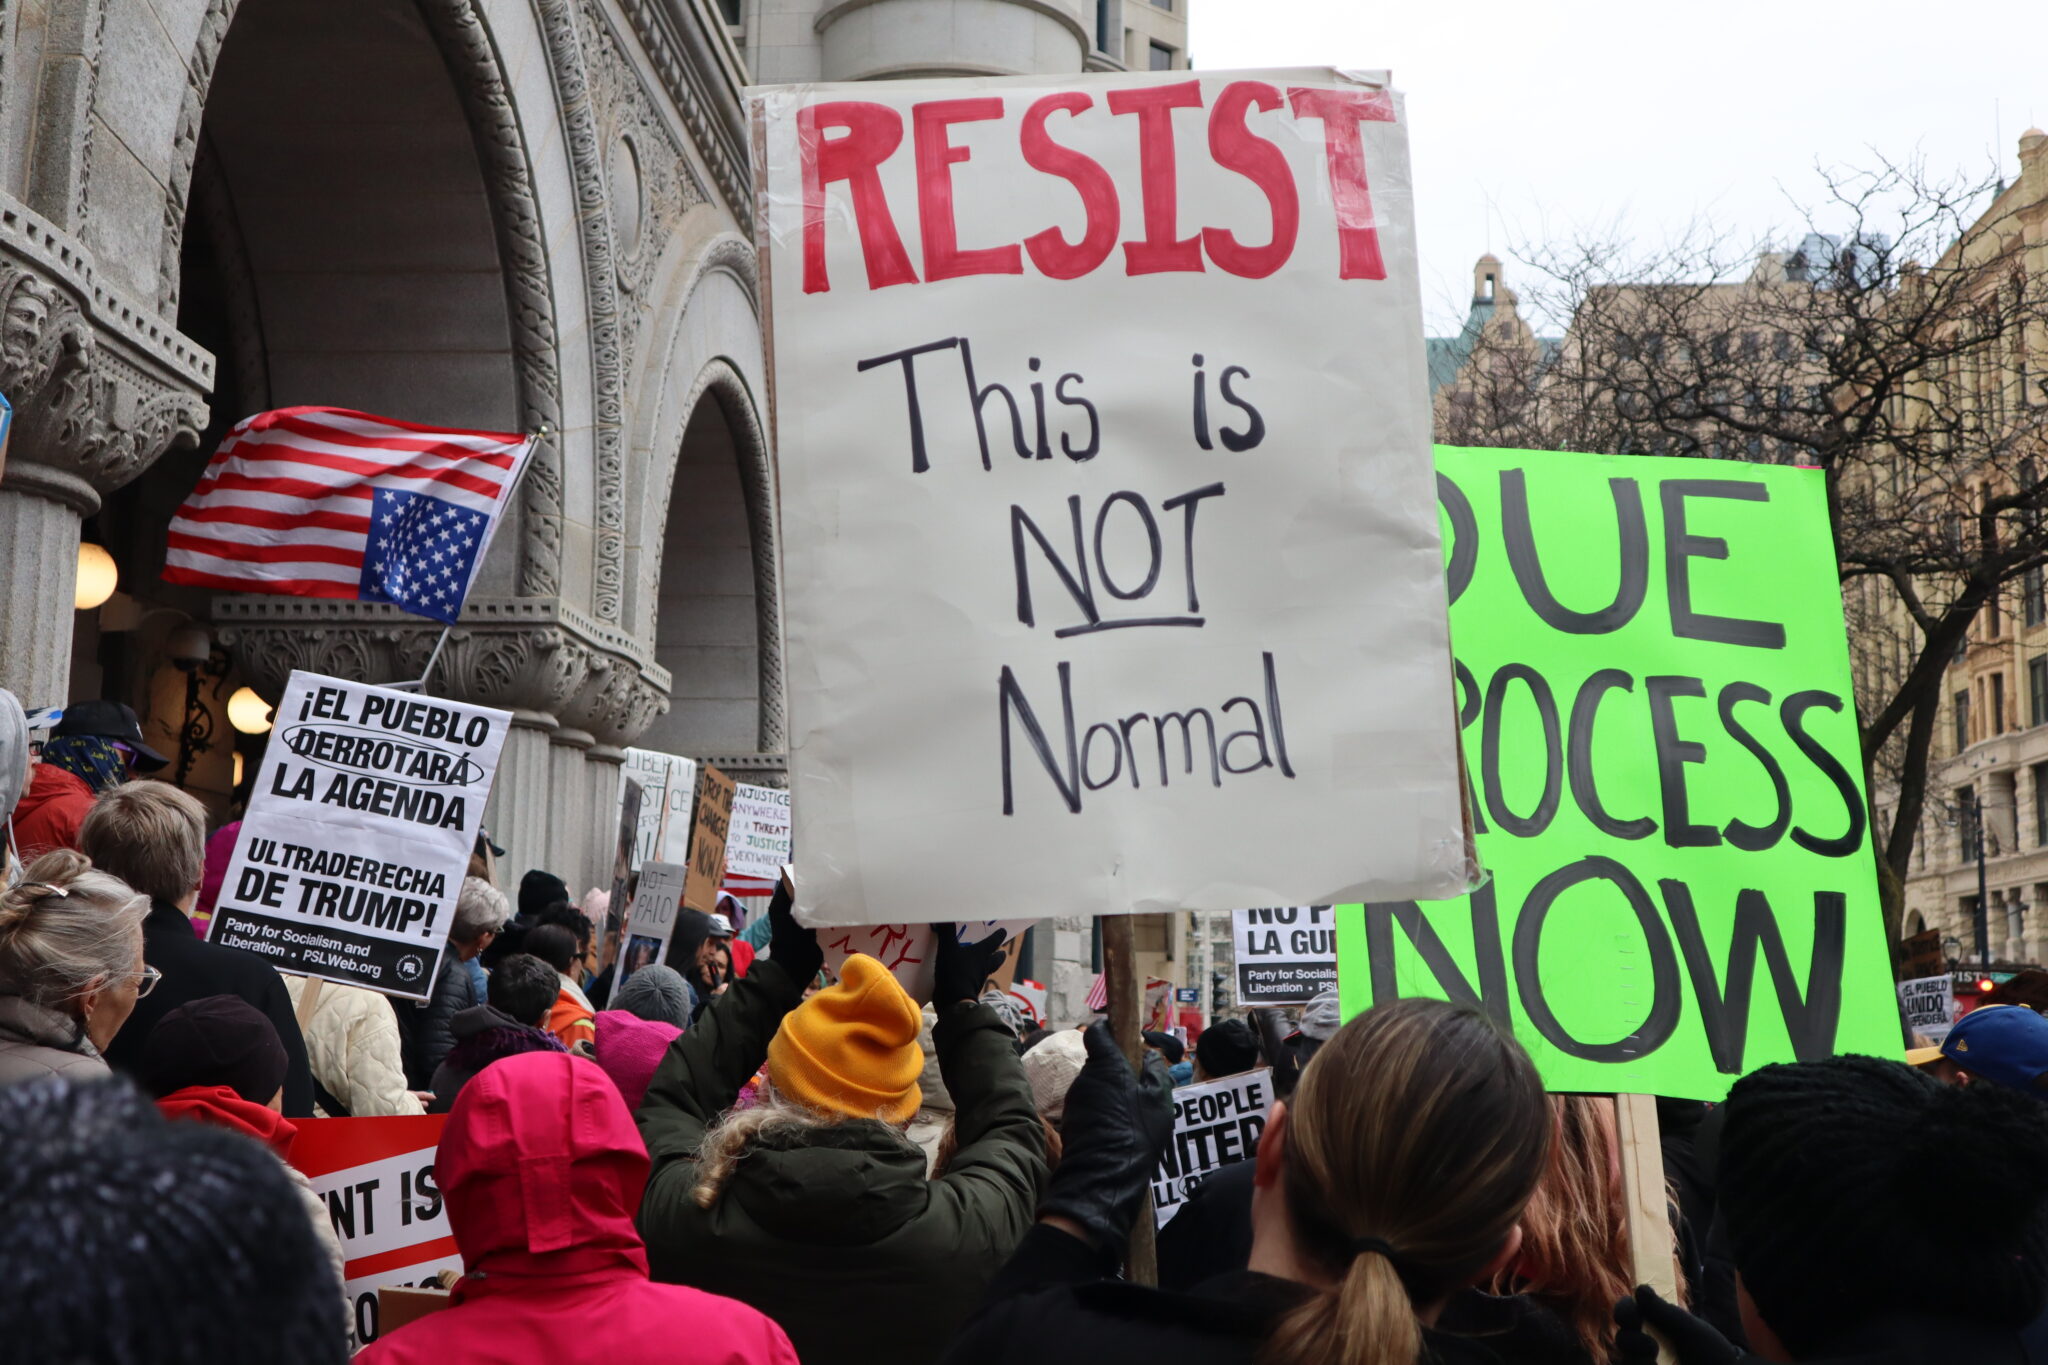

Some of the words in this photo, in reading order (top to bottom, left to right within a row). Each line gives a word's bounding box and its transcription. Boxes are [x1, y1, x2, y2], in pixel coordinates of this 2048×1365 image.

[796, 79, 1396, 294] RESIST
[857, 337, 1100, 473] This
[1191, 353, 1265, 452] is
[1010, 482, 1225, 630] NOT
[299, 686, 350, 722] ¡EL
[358, 694, 490, 748] PUEBLO
[997, 651, 1296, 816] Normal
[292, 728, 469, 787] DERROTARÁ
[271, 762, 316, 801] LA
[321, 774, 465, 831] AGENDA
[731, 802, 787, 820] ANYWHERE
[726, 846, 787, 867] EVERYWHERE
[746, 834, 788, 852] JUSTICE
[752, 821, 789, 836] THREAT
[247, 837, 445, 899] ULTRADERECHA
[235, 867, 289, 908] DE
[297, 877, 438, 937] TRUMP!
[220, 933, 285, 957] Liberation
[302, 949, 382, 979] PSLWeb.org
[225, 918, 260, 937] Party
[261, 925, 281, 939] for
[282, 929, 342, 950] Socialism
[344, 944, 371, 957] and
[1248, 930, 1283, 955] LA
[1364, 855, 1846, 1076] NOW
[1248, 970, 1278, 982] Party
[1279, 970, 1294, 979] for
[1249, 983, 1303, 994] Liberation
[1907, 994, 1944, 1014] UNIDO
[1916, 979, 1948, 993] PUEBLO
[1151, 1115, 1265, 1183] NITED
[401, 1165, 442, 1226] IS
